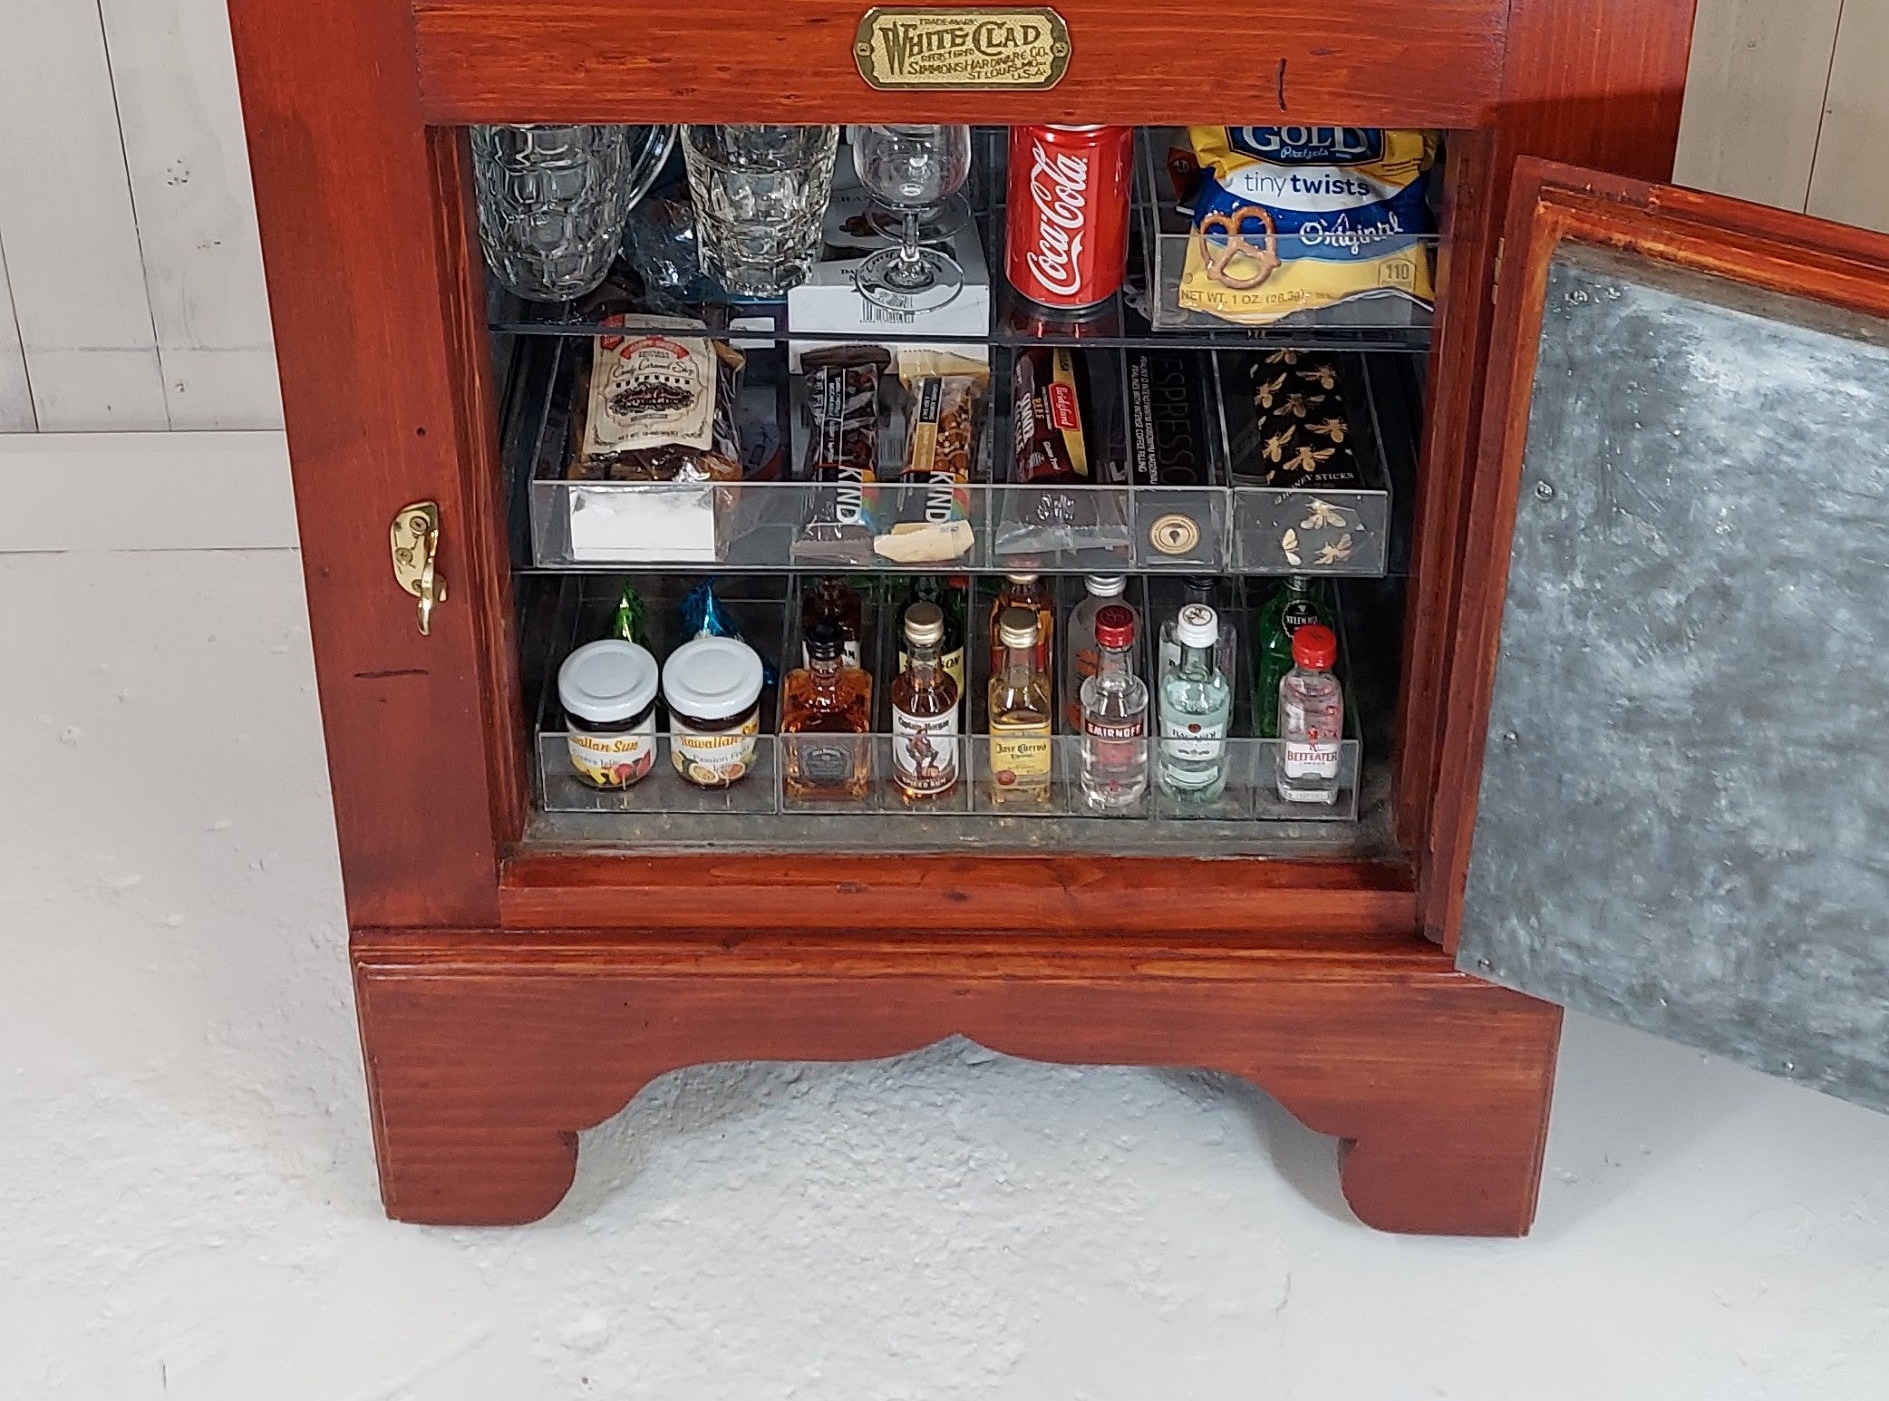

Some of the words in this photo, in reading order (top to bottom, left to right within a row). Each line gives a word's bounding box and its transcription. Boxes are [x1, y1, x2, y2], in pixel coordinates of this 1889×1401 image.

[878, 21, 969, 75] WHITE
[973, 21, 1041, 56] CLAD
[1243, 126, 1369, 154] GOLD
[1280, 145, 1330, 160] Pretzels
[1244, 172, 1287, 197] tiny
[1290, 174, 1371, 196] twists
[1027, 138, 1088, 296] Coca-Cola
[1299, 211, 1404, 255] Original
[1386, 263, 1410, 280] 110
[1181, 289, 1204, 302] NET
[1206, 291, 1228, 304] WT.
[1232, 294, 1238, 304] 1
[1032, 397, 1044, 419] BEEF
[1150, 356, 1197, 486] ESPRESSO
[1315, 472, 1354, 482] STICKS
[836, 465, 864, 525] KIND
[925, 470, 956, 524] KIND
[1087, 722, 1142, 738] SMIRNOFF
[613, 740, 640, 753] Sun
[1287, 750, 1338, 762] BEEFEATER
